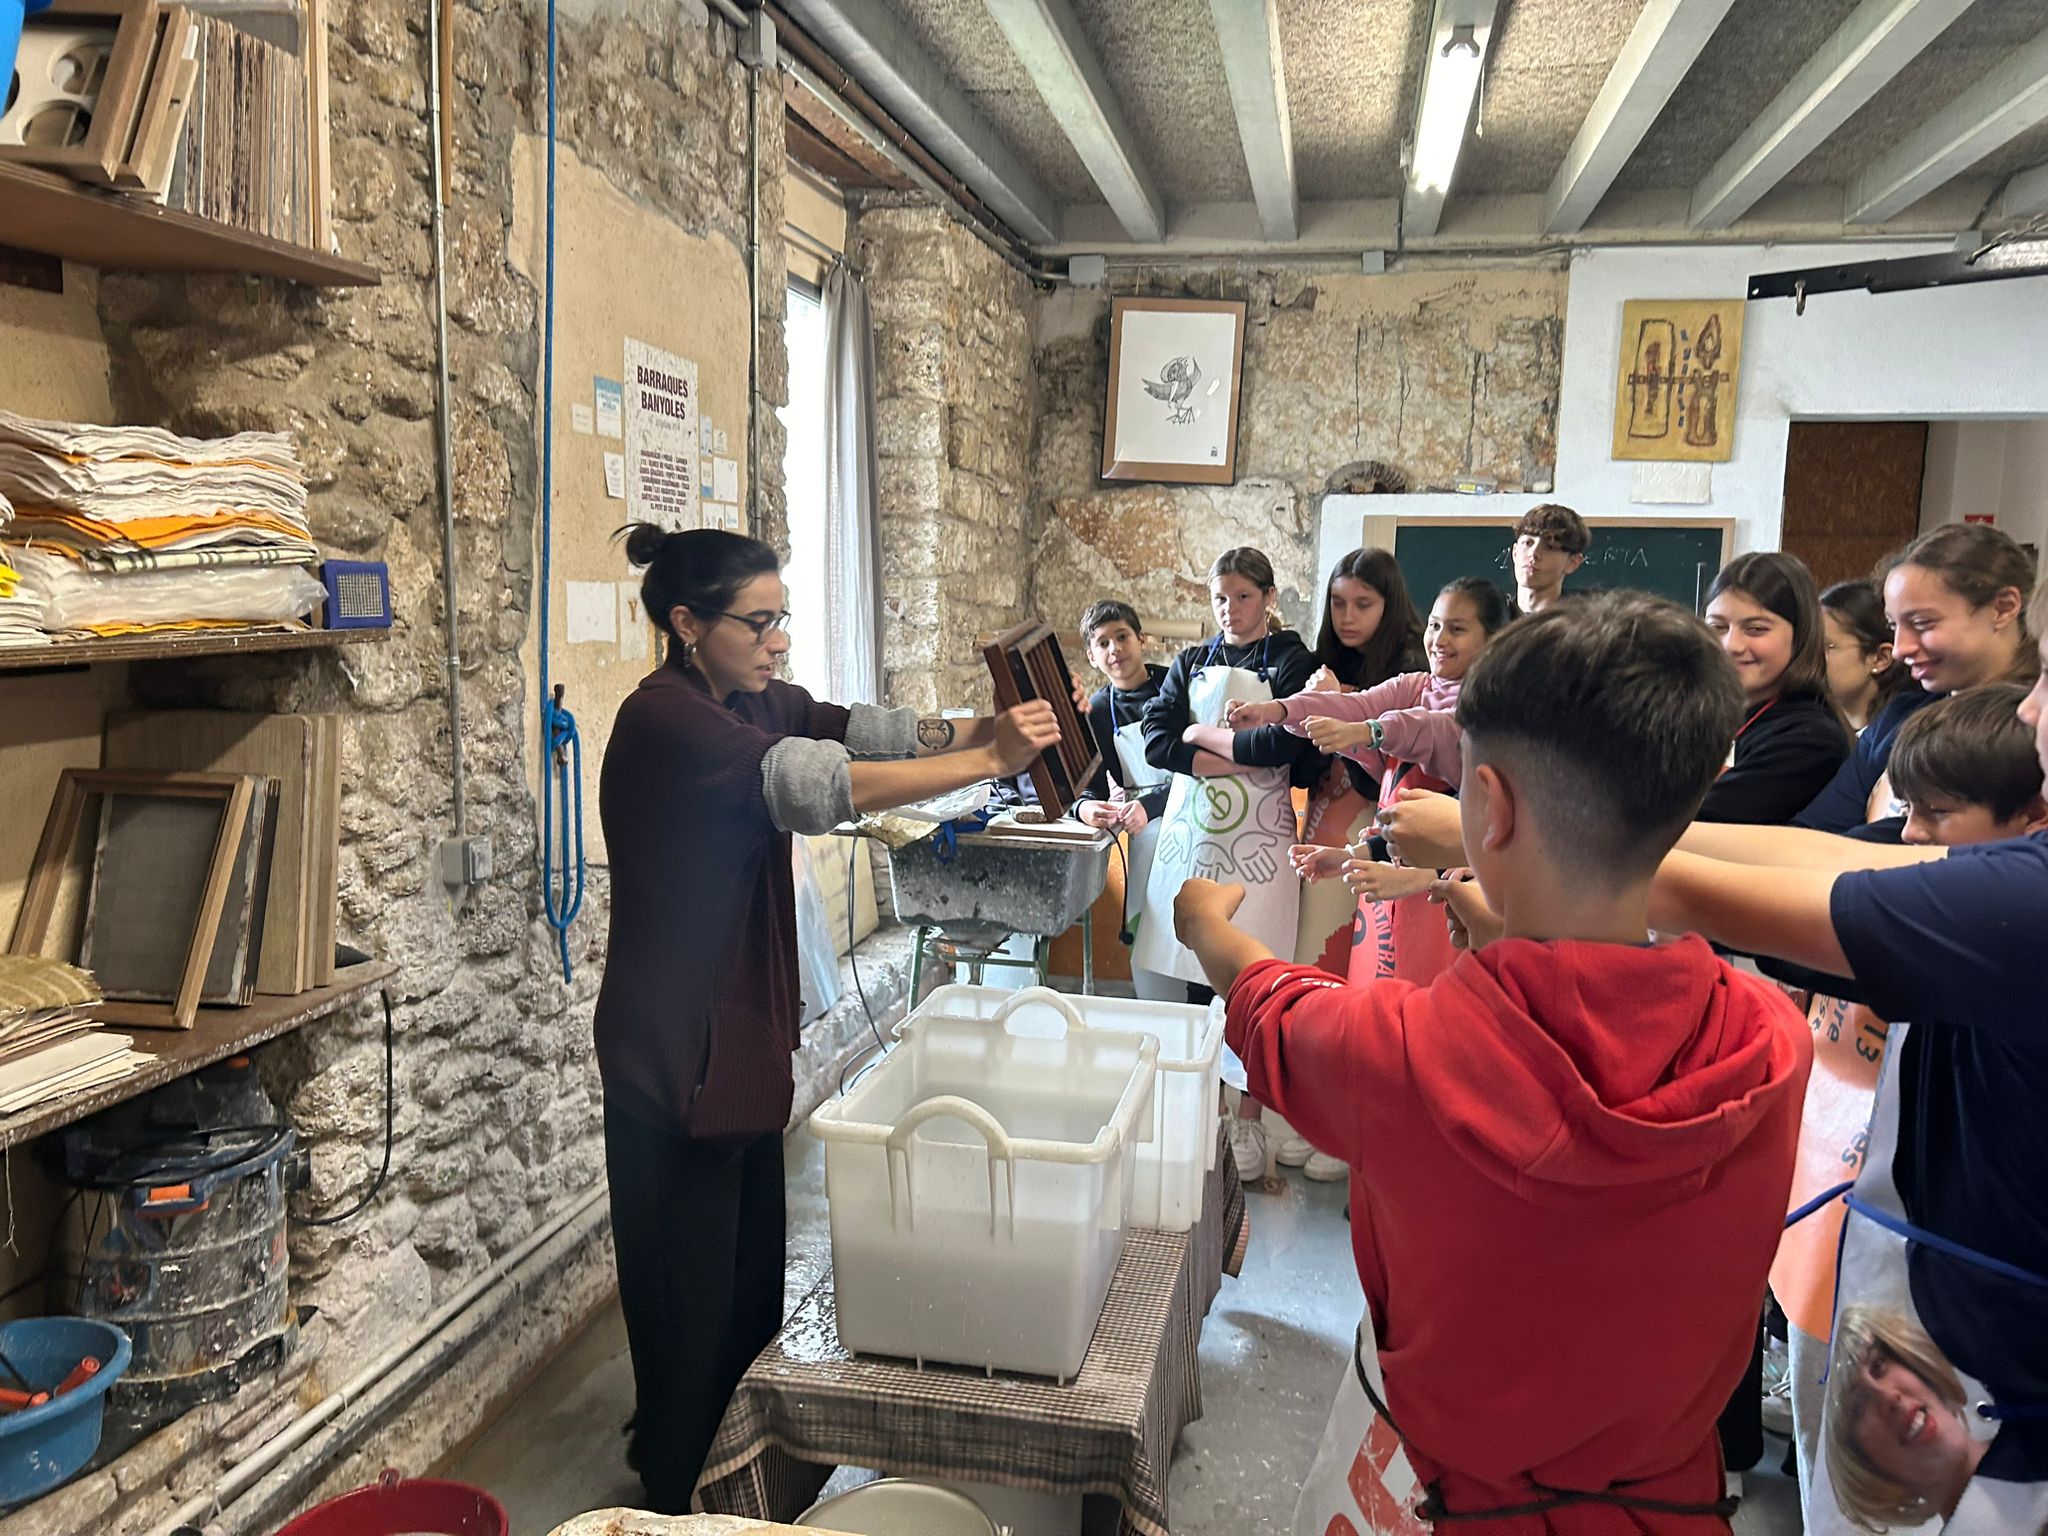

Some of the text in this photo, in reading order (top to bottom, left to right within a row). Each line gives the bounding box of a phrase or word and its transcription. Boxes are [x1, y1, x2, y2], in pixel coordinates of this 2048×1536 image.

[637, 365, 688, 398] BARRAQUES
[641, 390, 685, 420] BANYOLES
[1373, 899, 1396, 979] ONTRA
